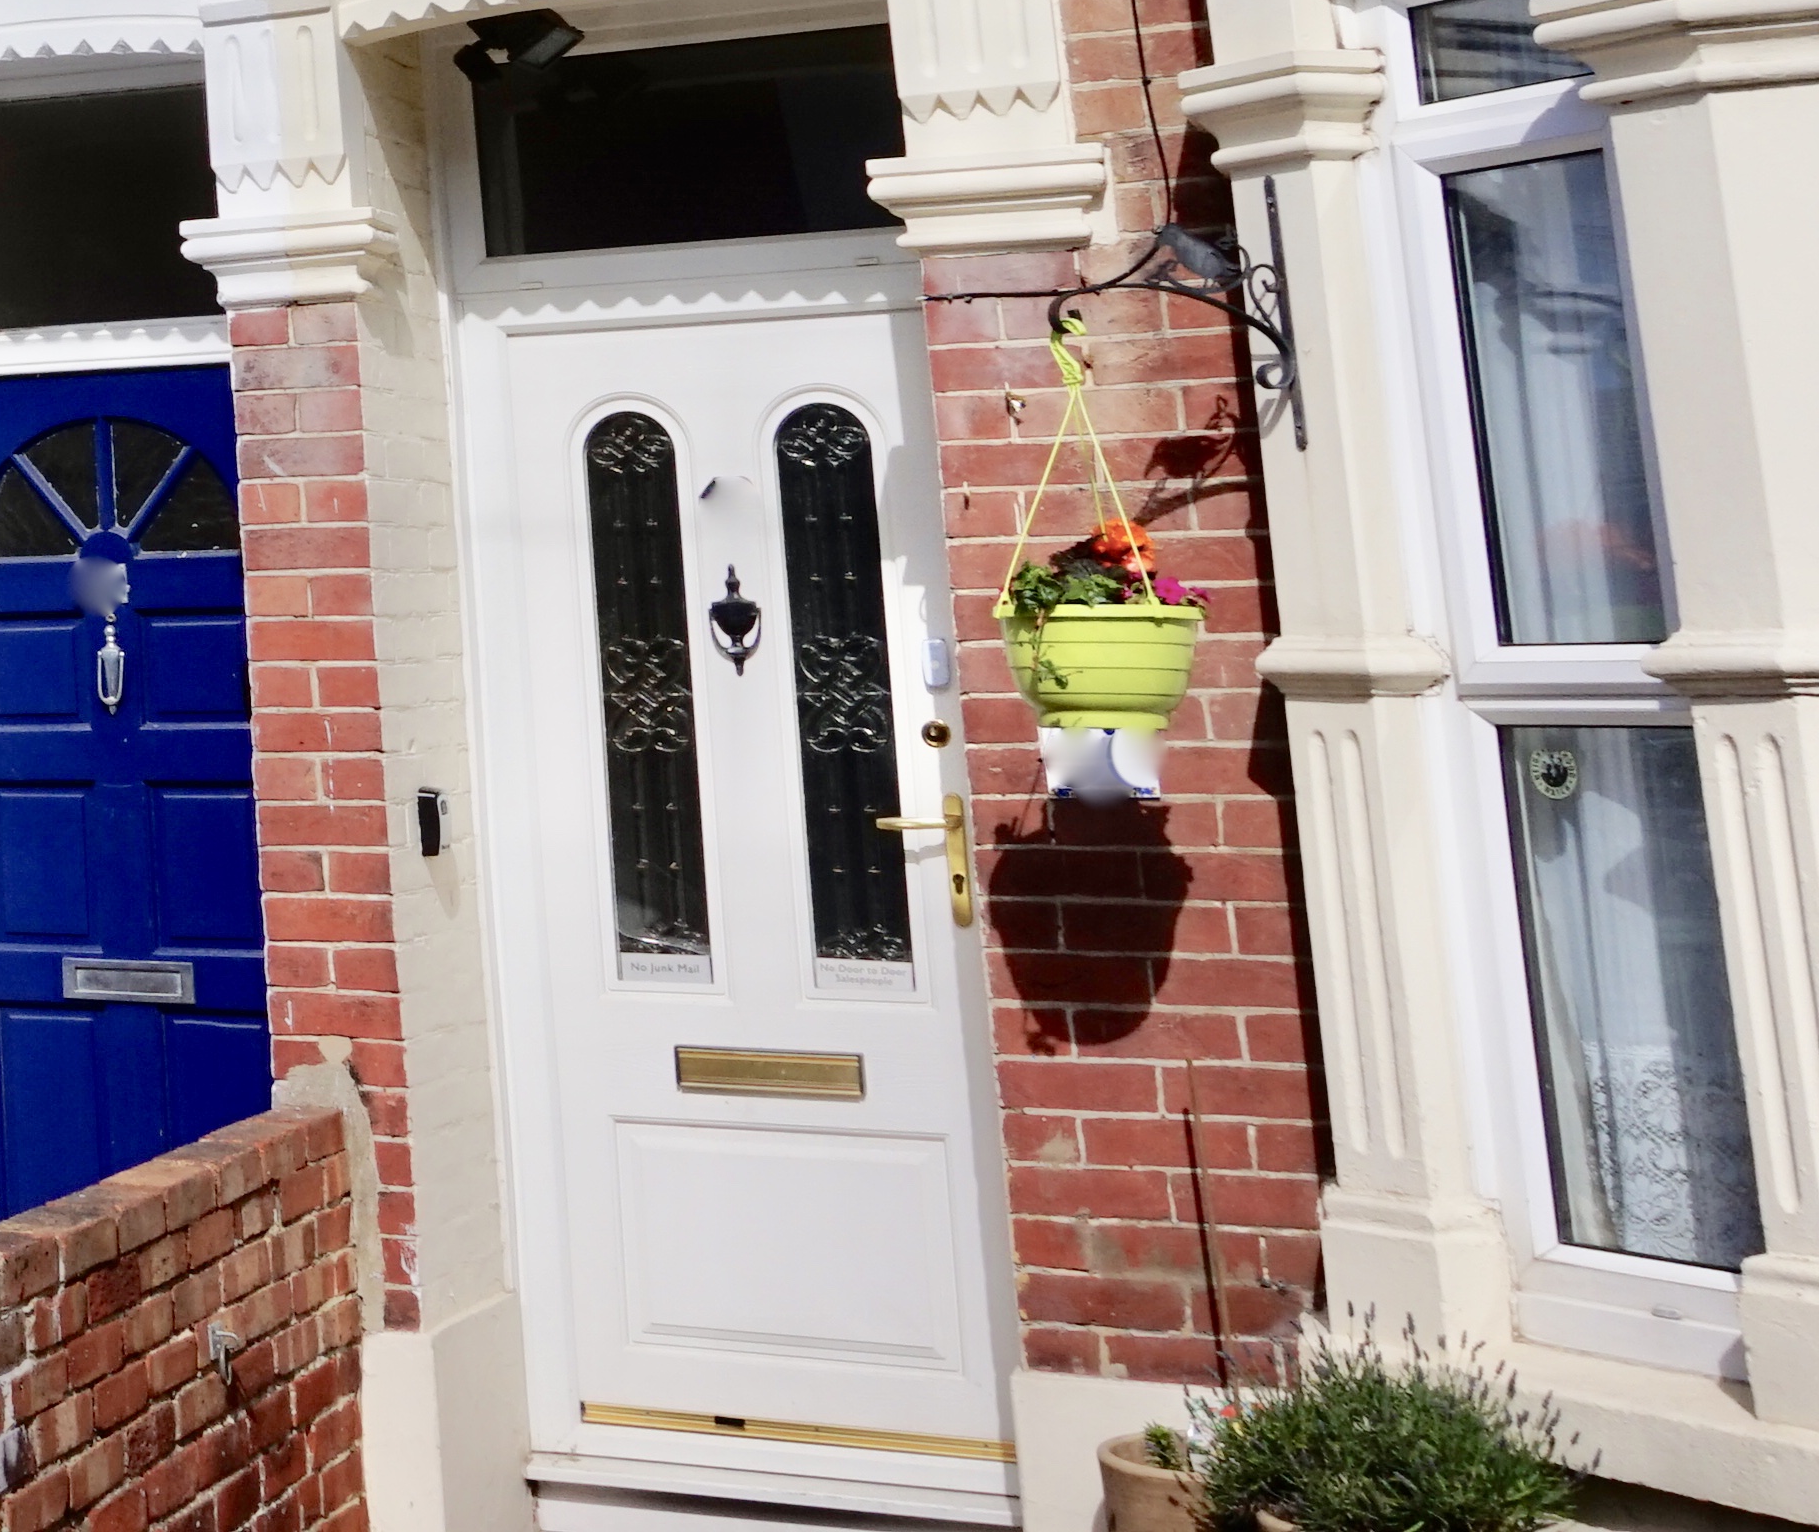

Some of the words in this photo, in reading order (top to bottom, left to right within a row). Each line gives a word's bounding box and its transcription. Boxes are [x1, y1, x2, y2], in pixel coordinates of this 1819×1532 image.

[630, 962, 648, 972] No
[650, 962, 674, 975] Junk
[677, 963, 700, 974] Mail
[838, 963, 863, 974] Door
